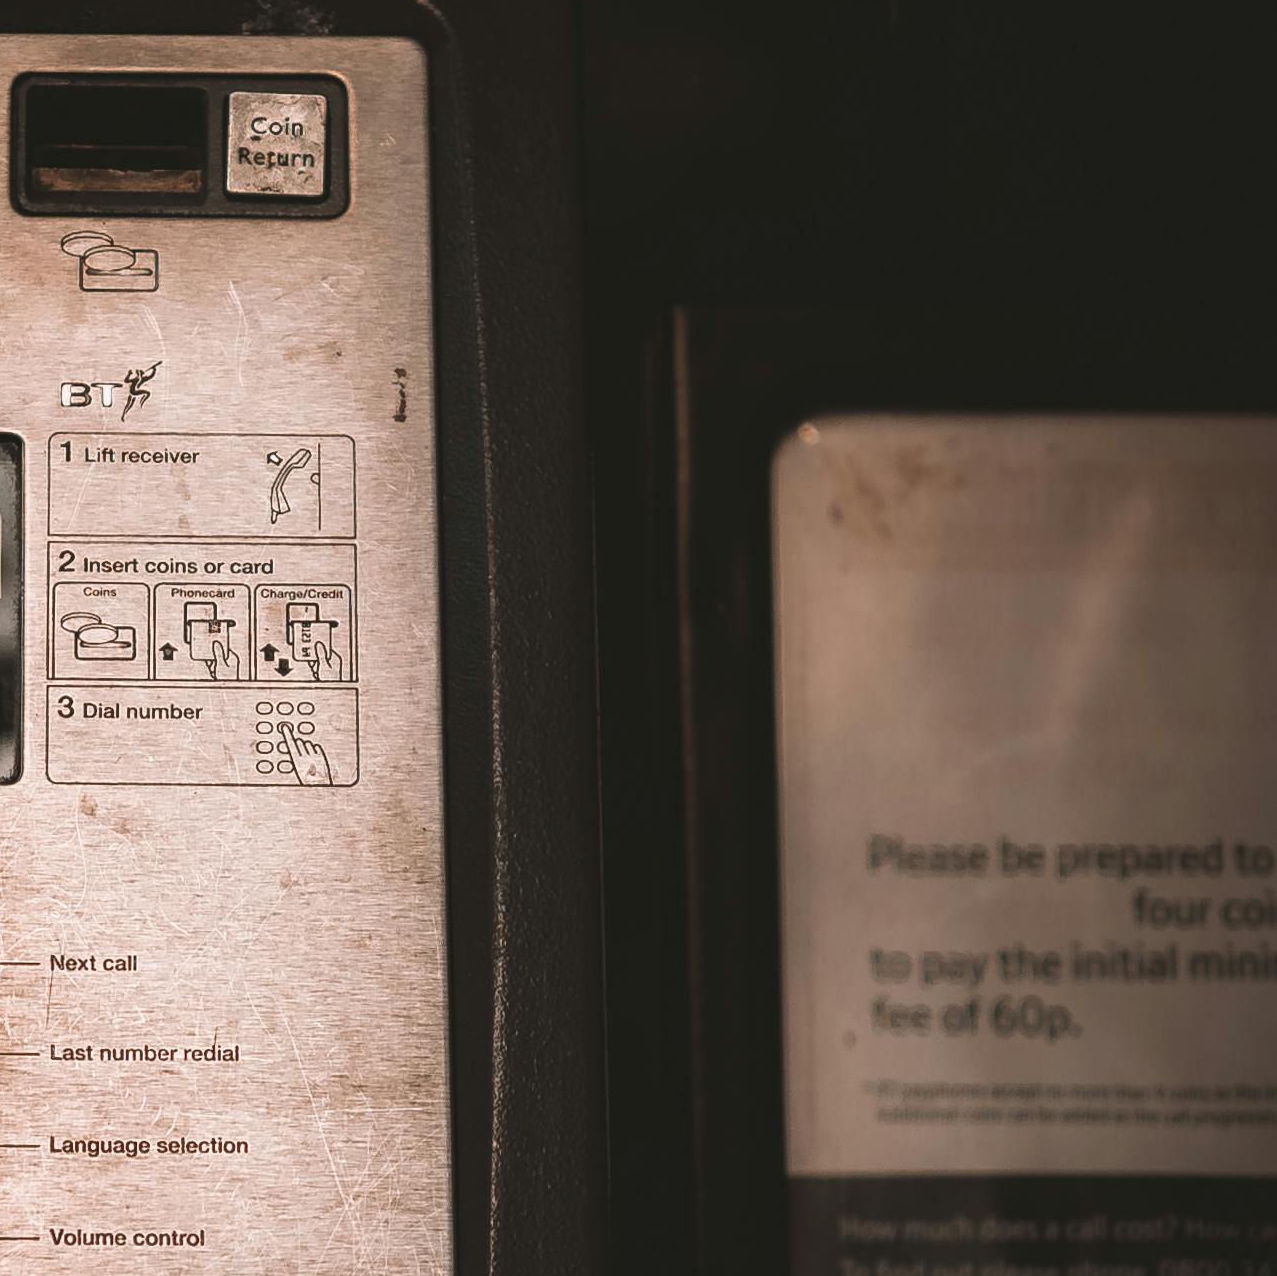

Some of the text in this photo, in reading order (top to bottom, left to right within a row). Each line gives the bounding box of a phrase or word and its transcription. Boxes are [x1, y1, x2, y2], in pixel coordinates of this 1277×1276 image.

[251, 116, 304, 137] Coin
[238, 147, 315, 168] Return
[61, 382, 123, 407] BT
[60, 440, 200, 464] 1 Lift receiver
[58, 549, 274, 574] 2 Insert coins or card
[83, 586, 117, 598] Coins
[171, 587, 235, 599] Phonecard
[260, 588, 344, 601] Charge/Credit
[57, 695, 203, 720] 3 Dial number
[866, 832, 1275, 884] Please be prepared to
[1132, 886, 1211, 930] four
[50, 954, 138, 971] Next call
[869, 940, 1277, 989] to pay the initial mini
[870, 992, 1083, 1045] fee of 60p.
[50, 1044, 240, 1062] Last number redial
[50, 1136, 249, 1157] Language selection
[49, 1229, 205, 1247] Volume control
[839, 1214, 897, 1242] How
[1044, 1220, 1059, 1241] a
[1066, 1213, 1107, 1241] call
